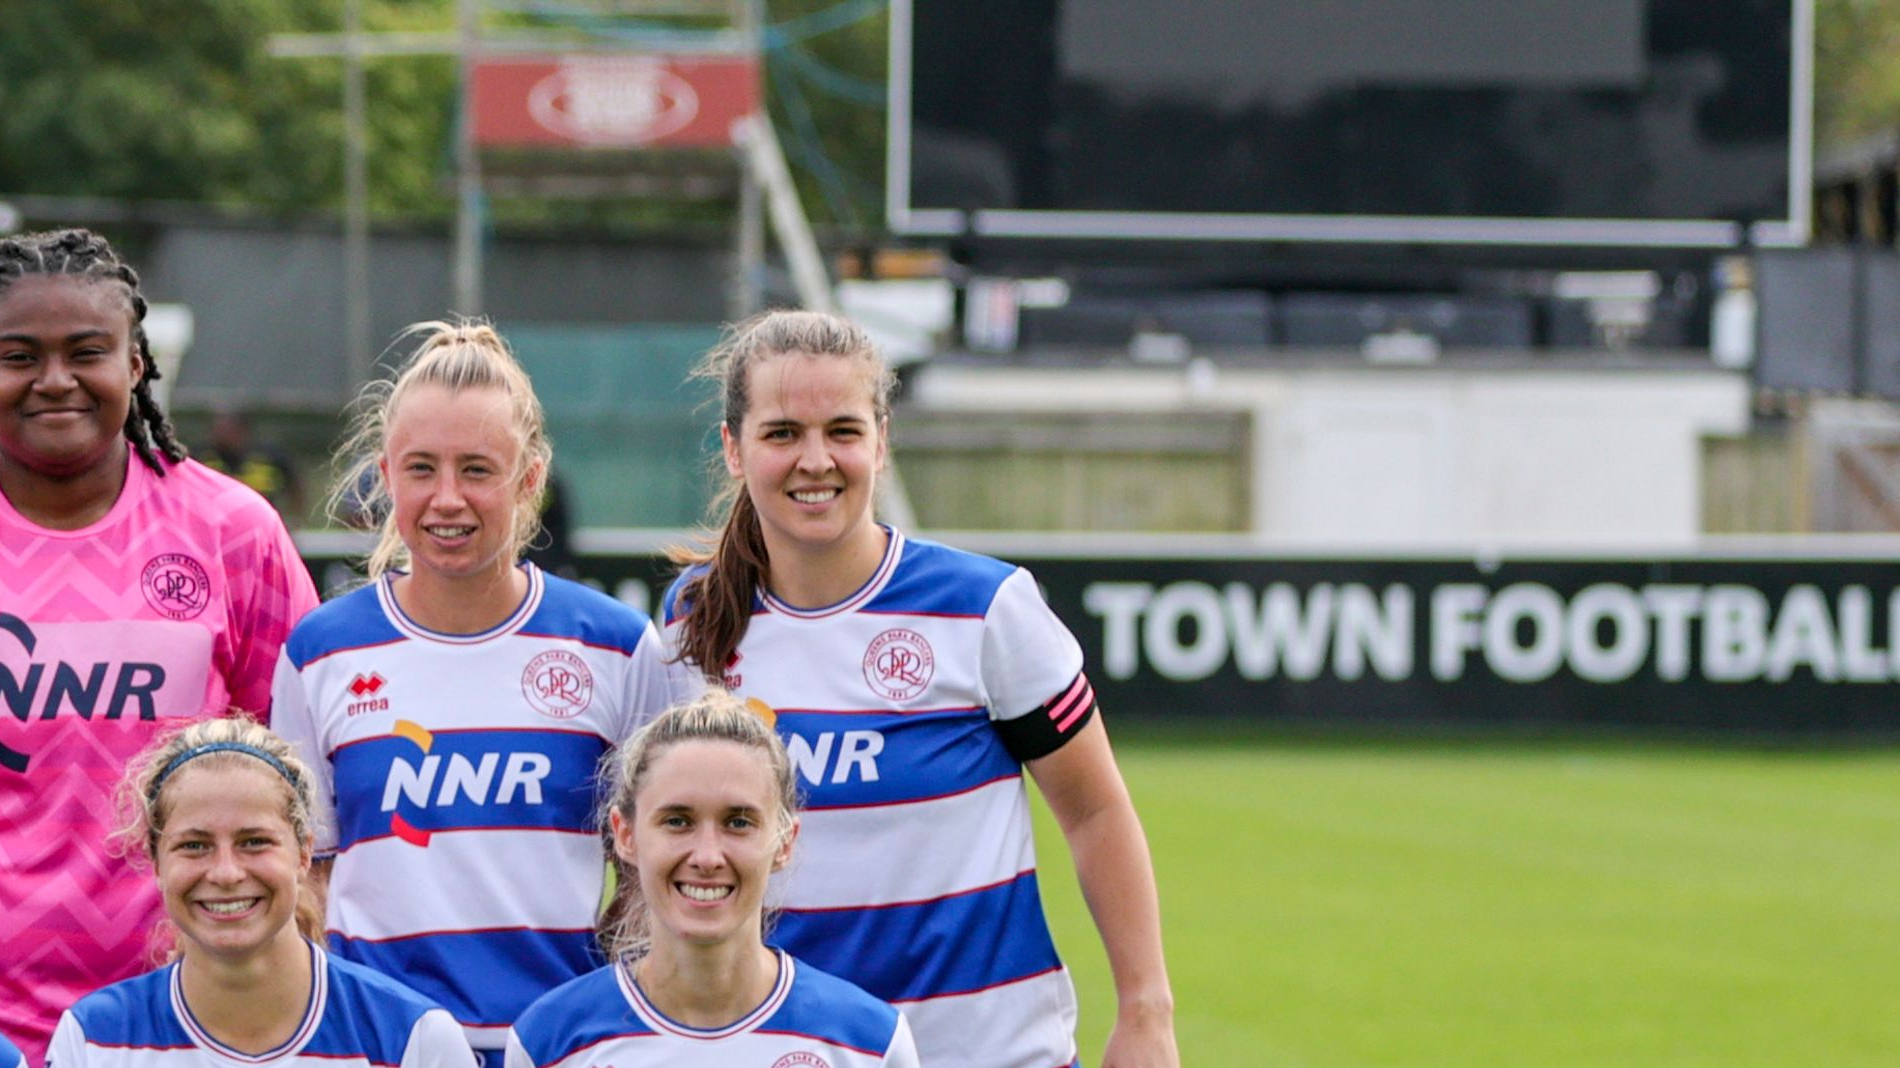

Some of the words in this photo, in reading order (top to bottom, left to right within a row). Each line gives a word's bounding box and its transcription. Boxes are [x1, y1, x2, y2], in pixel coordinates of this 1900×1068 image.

[1083, 578, 1414, 683] TOWN
[1430, 578, 1900, 683] FOOTBAL
[347, 697, 389, 717] errea
[380, 752, 551, 812] NNR
[786, 730, 885, 787] NR
